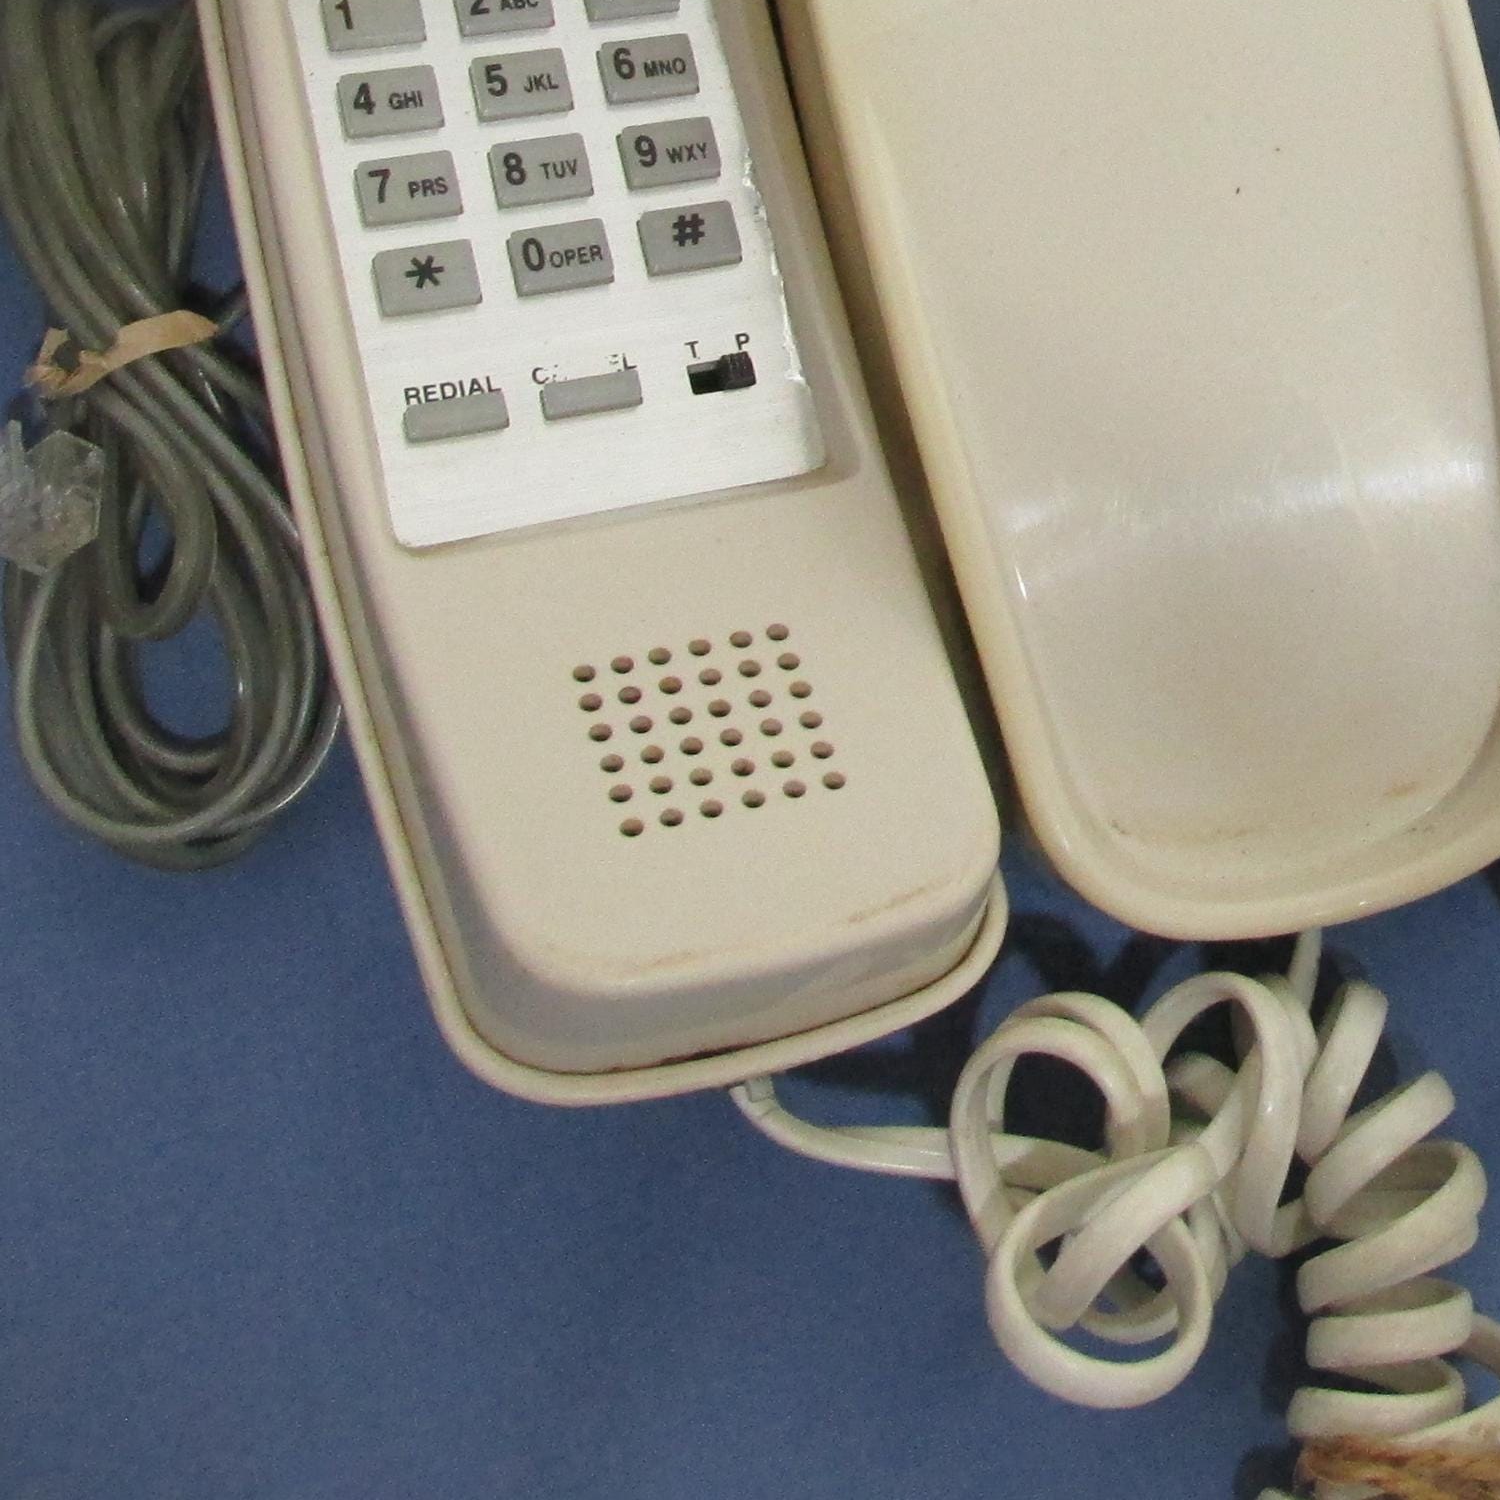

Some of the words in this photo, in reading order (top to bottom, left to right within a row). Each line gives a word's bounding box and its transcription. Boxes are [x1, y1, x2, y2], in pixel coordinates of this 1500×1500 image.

[613, 47, 636, 80] 6
[644, 58, 687, 77] MNO
[485, 64, 508, 97] 5
[523, 74, 559, 93] JKL
[353, 82, 376, 115] 4
[388, 90, 424, 111] GHI
[634, 135, 658, 168] 9
[665, 142, 708, 163] WXY
[503, 152, 527, 186] 8
[540, 160, 579, 180] TUV
[368, 169, 390, 203] 7
[408, 177, 448, 198] PRS
[522, 238, 545, 271] 0
[550, 245, 604, 269] OPER
[684, 341, 698, 359] T
[735, 333, 750, 350] P
[404, 375, 504, 406] REDIAL
